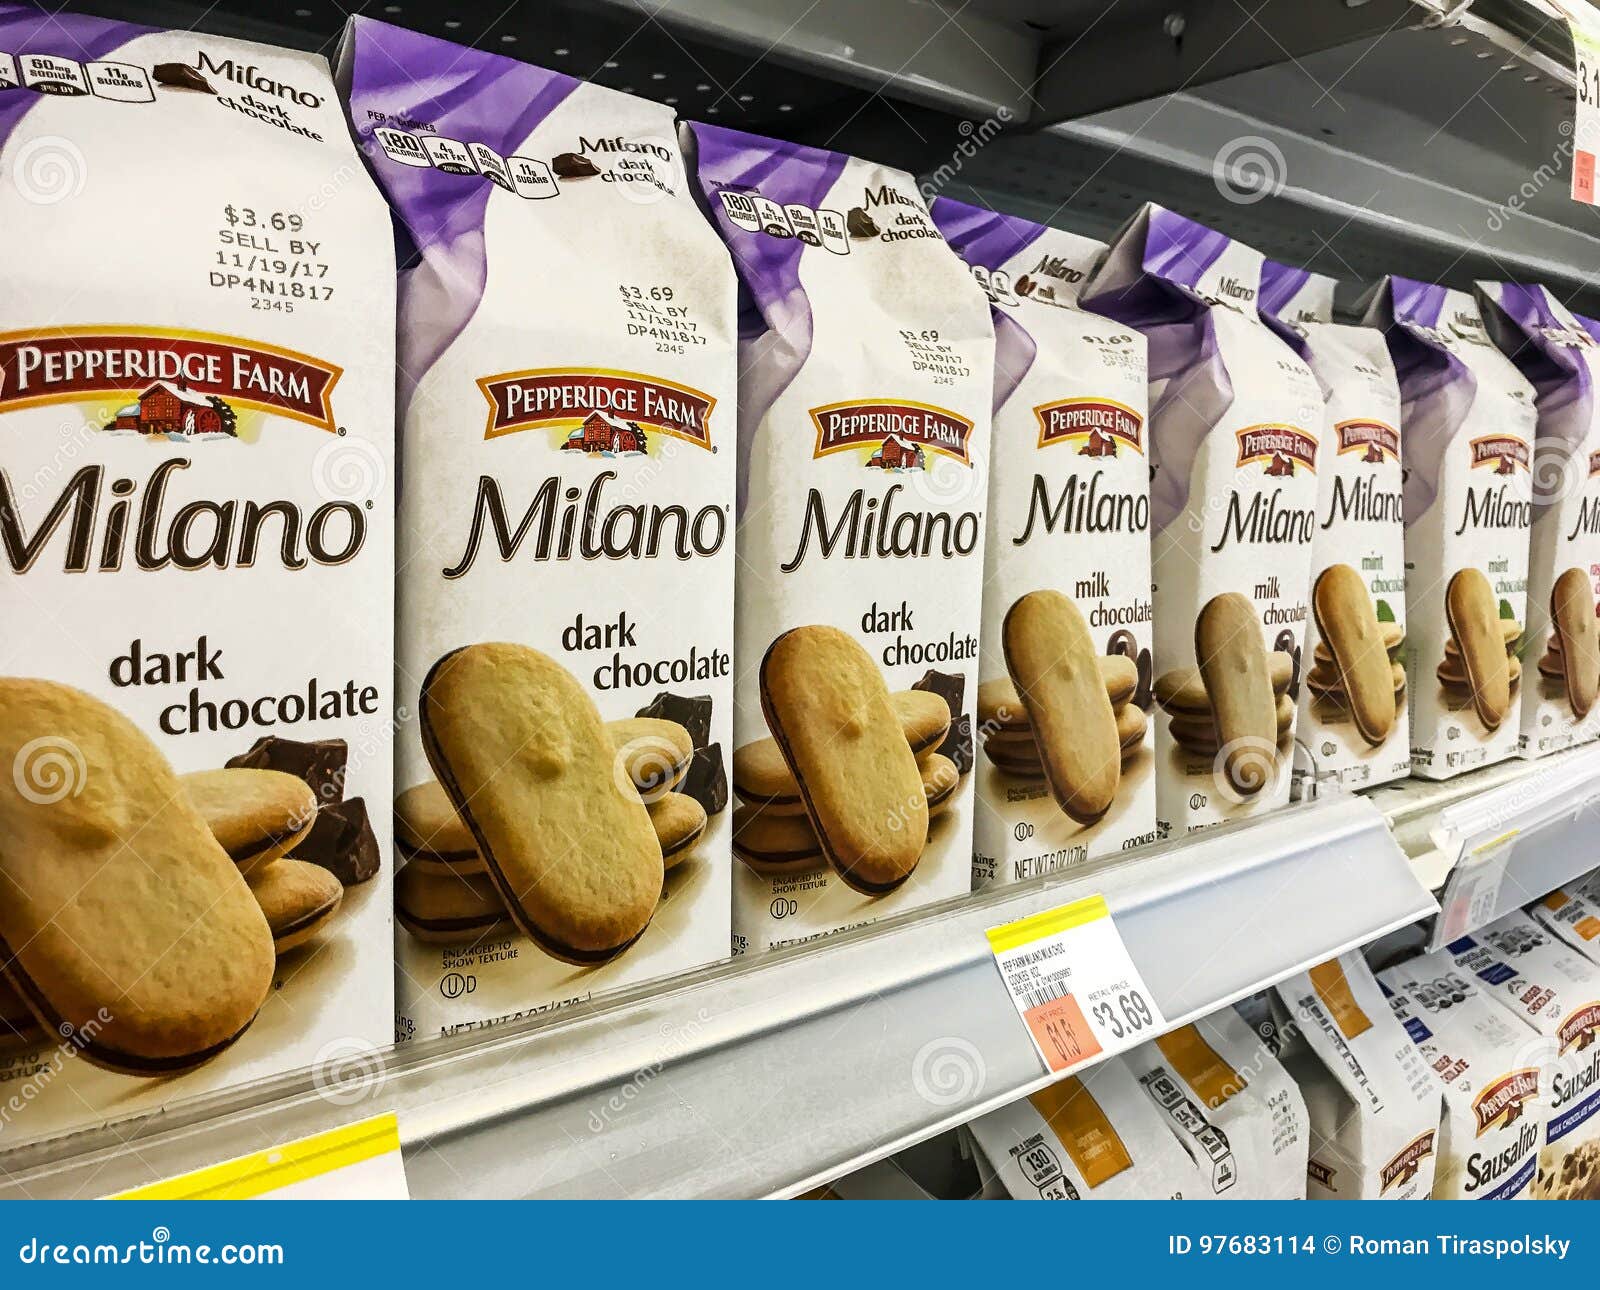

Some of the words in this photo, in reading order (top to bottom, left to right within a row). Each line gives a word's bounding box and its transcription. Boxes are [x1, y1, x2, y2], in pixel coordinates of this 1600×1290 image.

[30, 69, 78, 81] SODIUM
[31, 58, 71, 74] 60mg
[104, 67, 128, 79] 11g
[97, 77, 143, 88] SUGARS
[192, 51, 321, 108] Milano
[217, 96, 324, 142] chocolate
[241, 95, 292, 120] dark
[367, 110, 386, 123] PER
[379, 130, 420, 151] 180
[385, 146, 427, 160] CALORIES
[578, 136, 670, 162] Milano
[433, 152, 447, 160] SAT
[452, 154, 467, 162] FAT
[618, 158, 655, 174] dark
[515, 174, 548, 184] SUGARS
[519, 164, 537, 177] 11g
[601, 169, 676, 197] chocolate
[722, 193, 752, 213] 180
[224, 204, 304, 232] $3.69
[895, 212, 927, 226] dark
[219, 230, 279, 253] SELL
[290, 240, 321, 256] BY
[216, 251, 329, 278] 11/19/17
[209, 271, 334, 301] DP4N1817
[619, 285, 674, 301] $3.69
[251, 298, 294, 313] 2345
[623, 299, 662, 314] SELL
[666, 306, 688, 318] BY
[627, 310, 697, 332] 11/19/17
[627, 323, 707, 345] DP4N1817
[655, 342, 685, 354] 2345
[17, 347, 224, 390] PEPPERIDGE
[231, 353, 311, 404] FARM
[912, 361, 970, 376] DP4N1817
[505, 384, 638, 419] PEPPERIDGE
[643, 387, 697, 428] FARM
[828, 413, 920, 442] PEPPERIDGE
[924, 414, 960, 446] FARM
[1050, 410, 1114, 434] PEPPERIDGE
[1115, 413, 1137, 439] FARM
[0, 457, 367, 575] Milano
[1012, 470, 1149, 546] Milano
[1211, 488, 1315, 552] Milano
[1456, 485, 1531, 536] Milano
[441, 470, 727, 580] Milano
[779, 484, 978, 573] Milano
[1361, 551, 1383, 571] mint
[1075, 571, 1110, 599] milk
[1254, 576, 1281, 599] milk
[861, 601, 914, 634] dark
[1090, 598, 1152, 627] chocolate
[561, 611, 638, 651] dark
[109, 635, 225, 687] dark
[882, 632, 978, 667] chocolate
[593, 647, 730, 690] chocolate
[159, 678, 379, 735] chocolate
[1014, 858, 1033, 880] NET
[1034, 854, 1050, 874] WT
[771, 885, 797, 894] SHOW
[799, 879, 828, 890] TEXTURE
[496, 941, 512, 951] TO
[442, 957, 474, 969] SHOW
[478, 950, 519, 965] TEXTURE
[1088, 987, 1111, 1001] RETAIL
[1111, 980, 1131, 993] PRICE
[1093, 990, 1153, 1038] $3.69
[1026, 1148, 1051, 1171] 130
[1464, 1122, 1538, 1192] Sausalito
